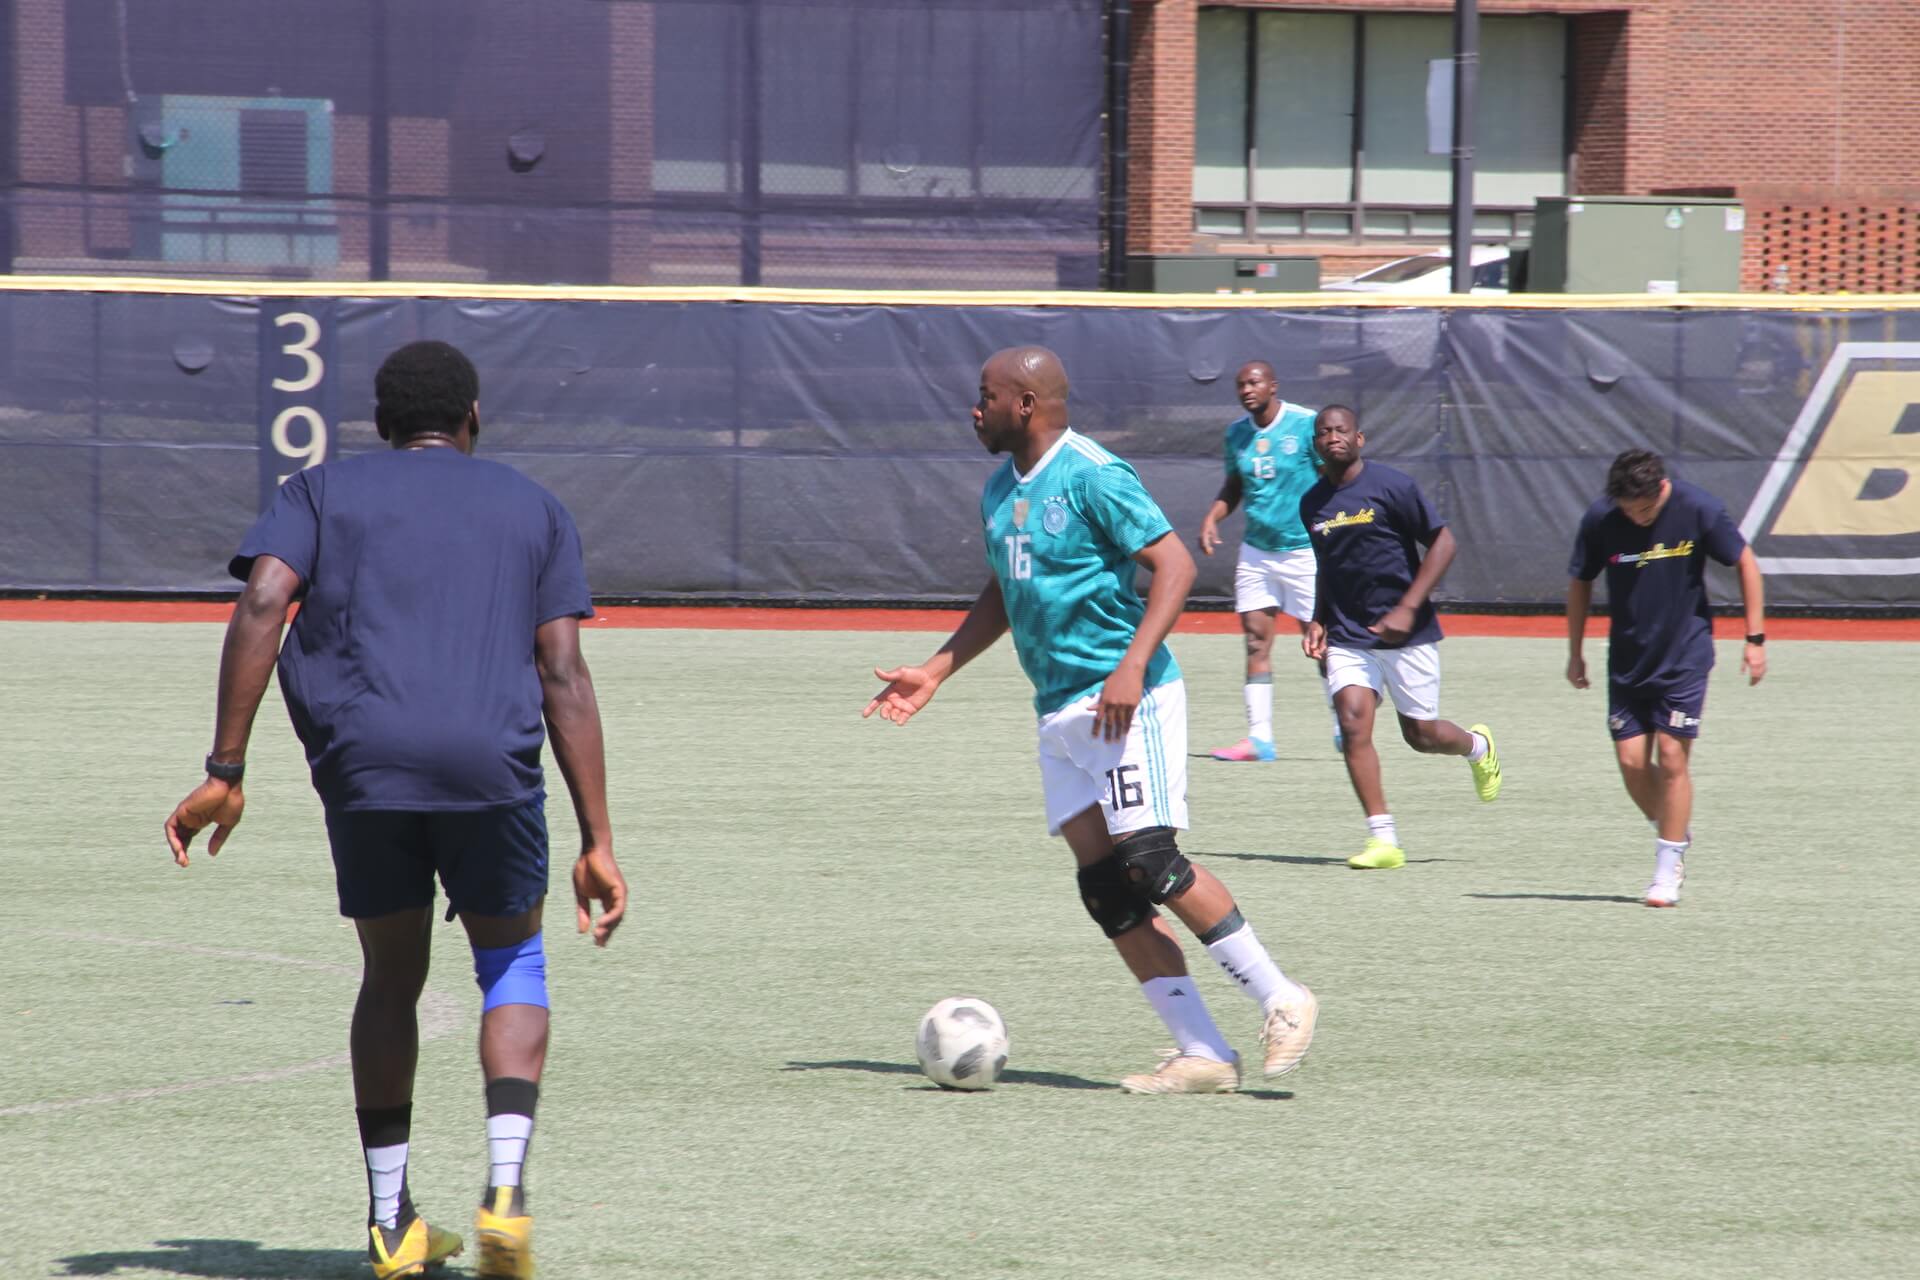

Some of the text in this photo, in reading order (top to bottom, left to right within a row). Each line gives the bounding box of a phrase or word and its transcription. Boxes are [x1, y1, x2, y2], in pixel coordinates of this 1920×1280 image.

[1768, 369, 1920, 537] B
[1005, 534, 1031, 580] 16
[1105, 764, 1144, 811] 16
